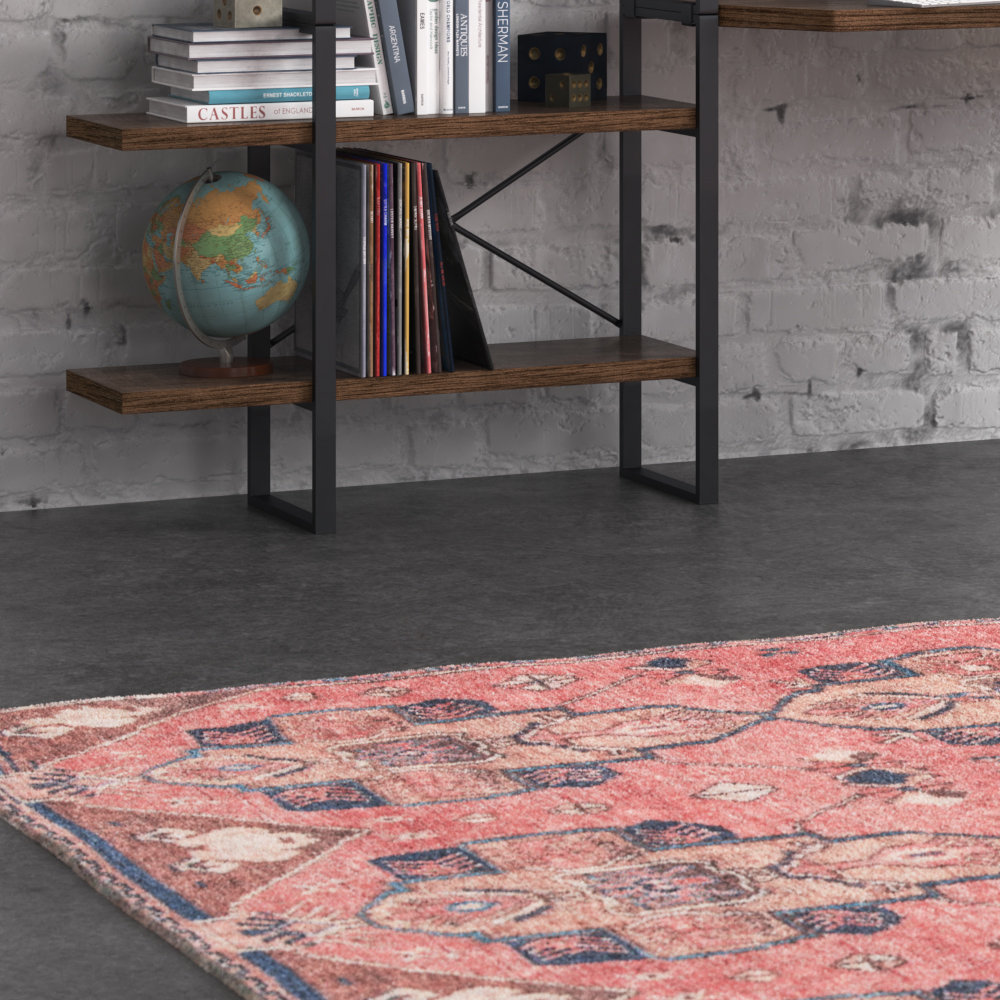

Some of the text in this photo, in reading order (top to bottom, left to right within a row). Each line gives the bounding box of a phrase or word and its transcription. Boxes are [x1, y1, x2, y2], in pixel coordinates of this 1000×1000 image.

[371, 33, 383, 65] DESIGN
[388, 25, 401, 64] ARGENTINA
[460, 13, 468, 57] ANTIQUES
[497, 1, 509, 63] SHERMAN
[198, 105, 266, 121] CASTLES
[273, 107, 281, 115] of
